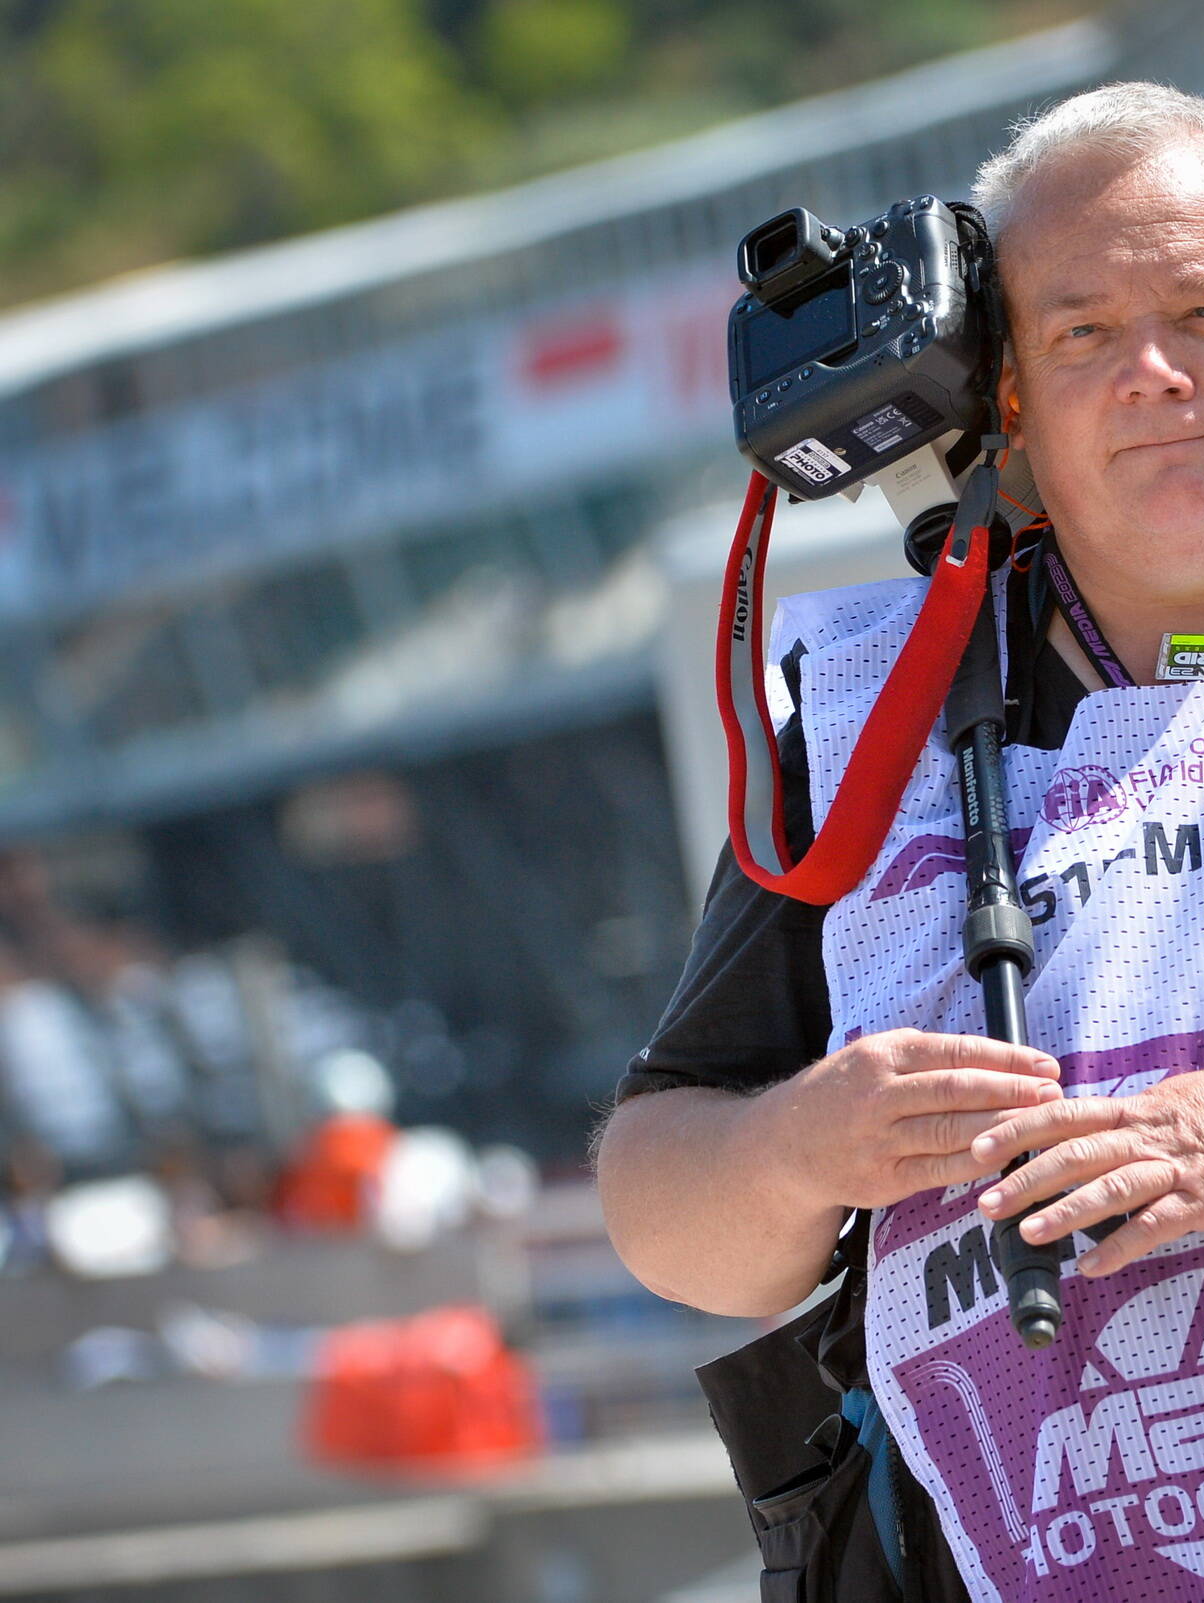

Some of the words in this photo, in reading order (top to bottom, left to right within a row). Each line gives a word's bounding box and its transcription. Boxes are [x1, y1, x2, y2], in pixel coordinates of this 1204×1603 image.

[733, 547, 753, 641] Canon
[1050, 564, 1078, 604] 2023
[1069, 601, 1110, 656] MEDIA
[962, 746, 979, 826] Manfrotto
